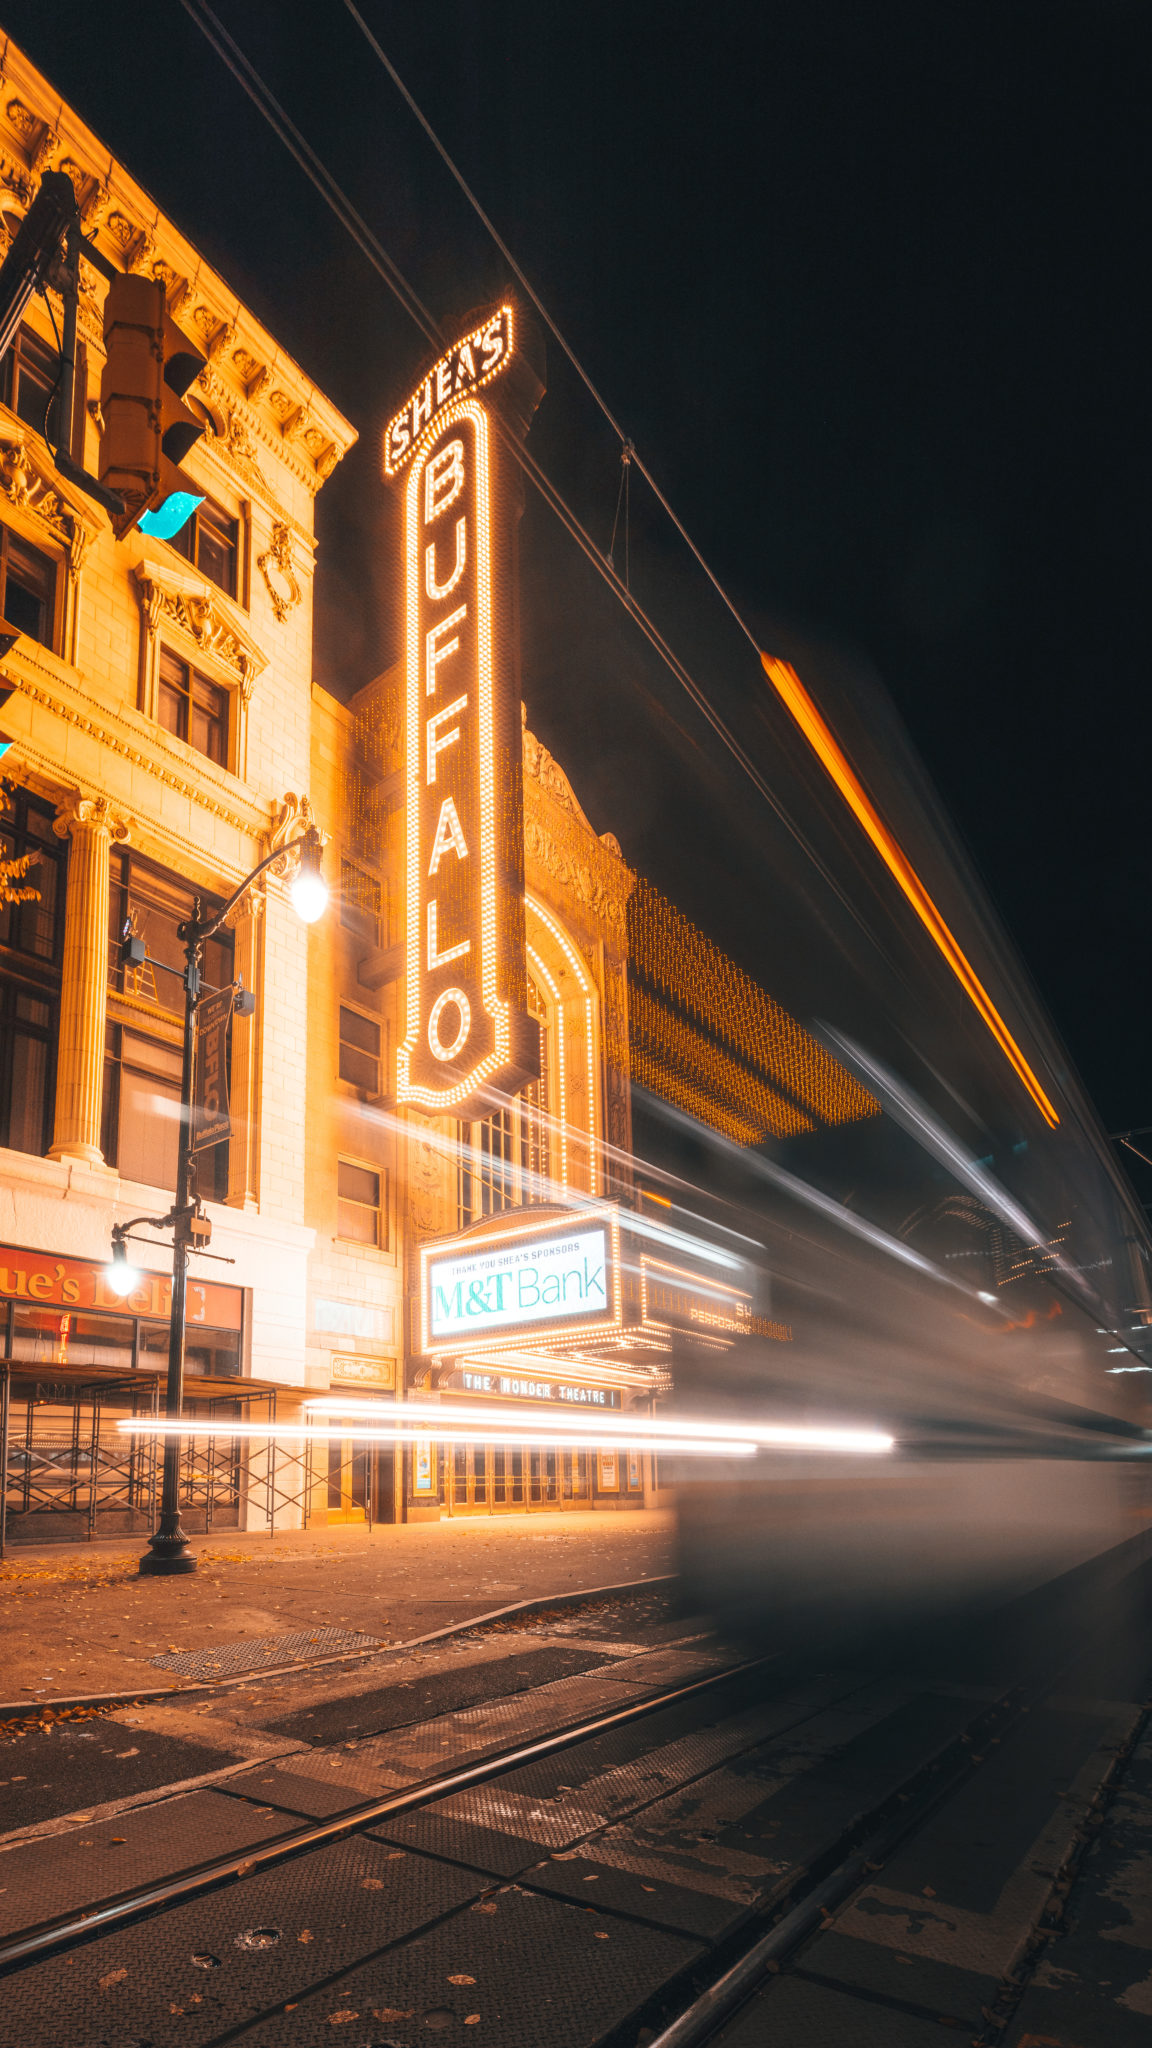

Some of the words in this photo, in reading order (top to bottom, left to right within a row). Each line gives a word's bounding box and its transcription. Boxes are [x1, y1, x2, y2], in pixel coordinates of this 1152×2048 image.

[391, 319, 504, 460] SHEA'S
[424, 439, 472, 1062] BUFFALO
[451, 1263, 477, 1276] THANK
[479, 1259, 496, 1271] YOU
[498, 1252, 529, 1267] SHEA'S
[531, 1242, 580, 1260] SPONSORS
[91, 1269, 172, 1317] Deli
[432, 1271, 513, 1322] M&T
[518, 1256, 605, 1309] Bank
[465, 1373, 491, 1391] THE
[501, 1377, 551, 1398] WONDER
[559, 1386, 605, 1404] THEATRE
